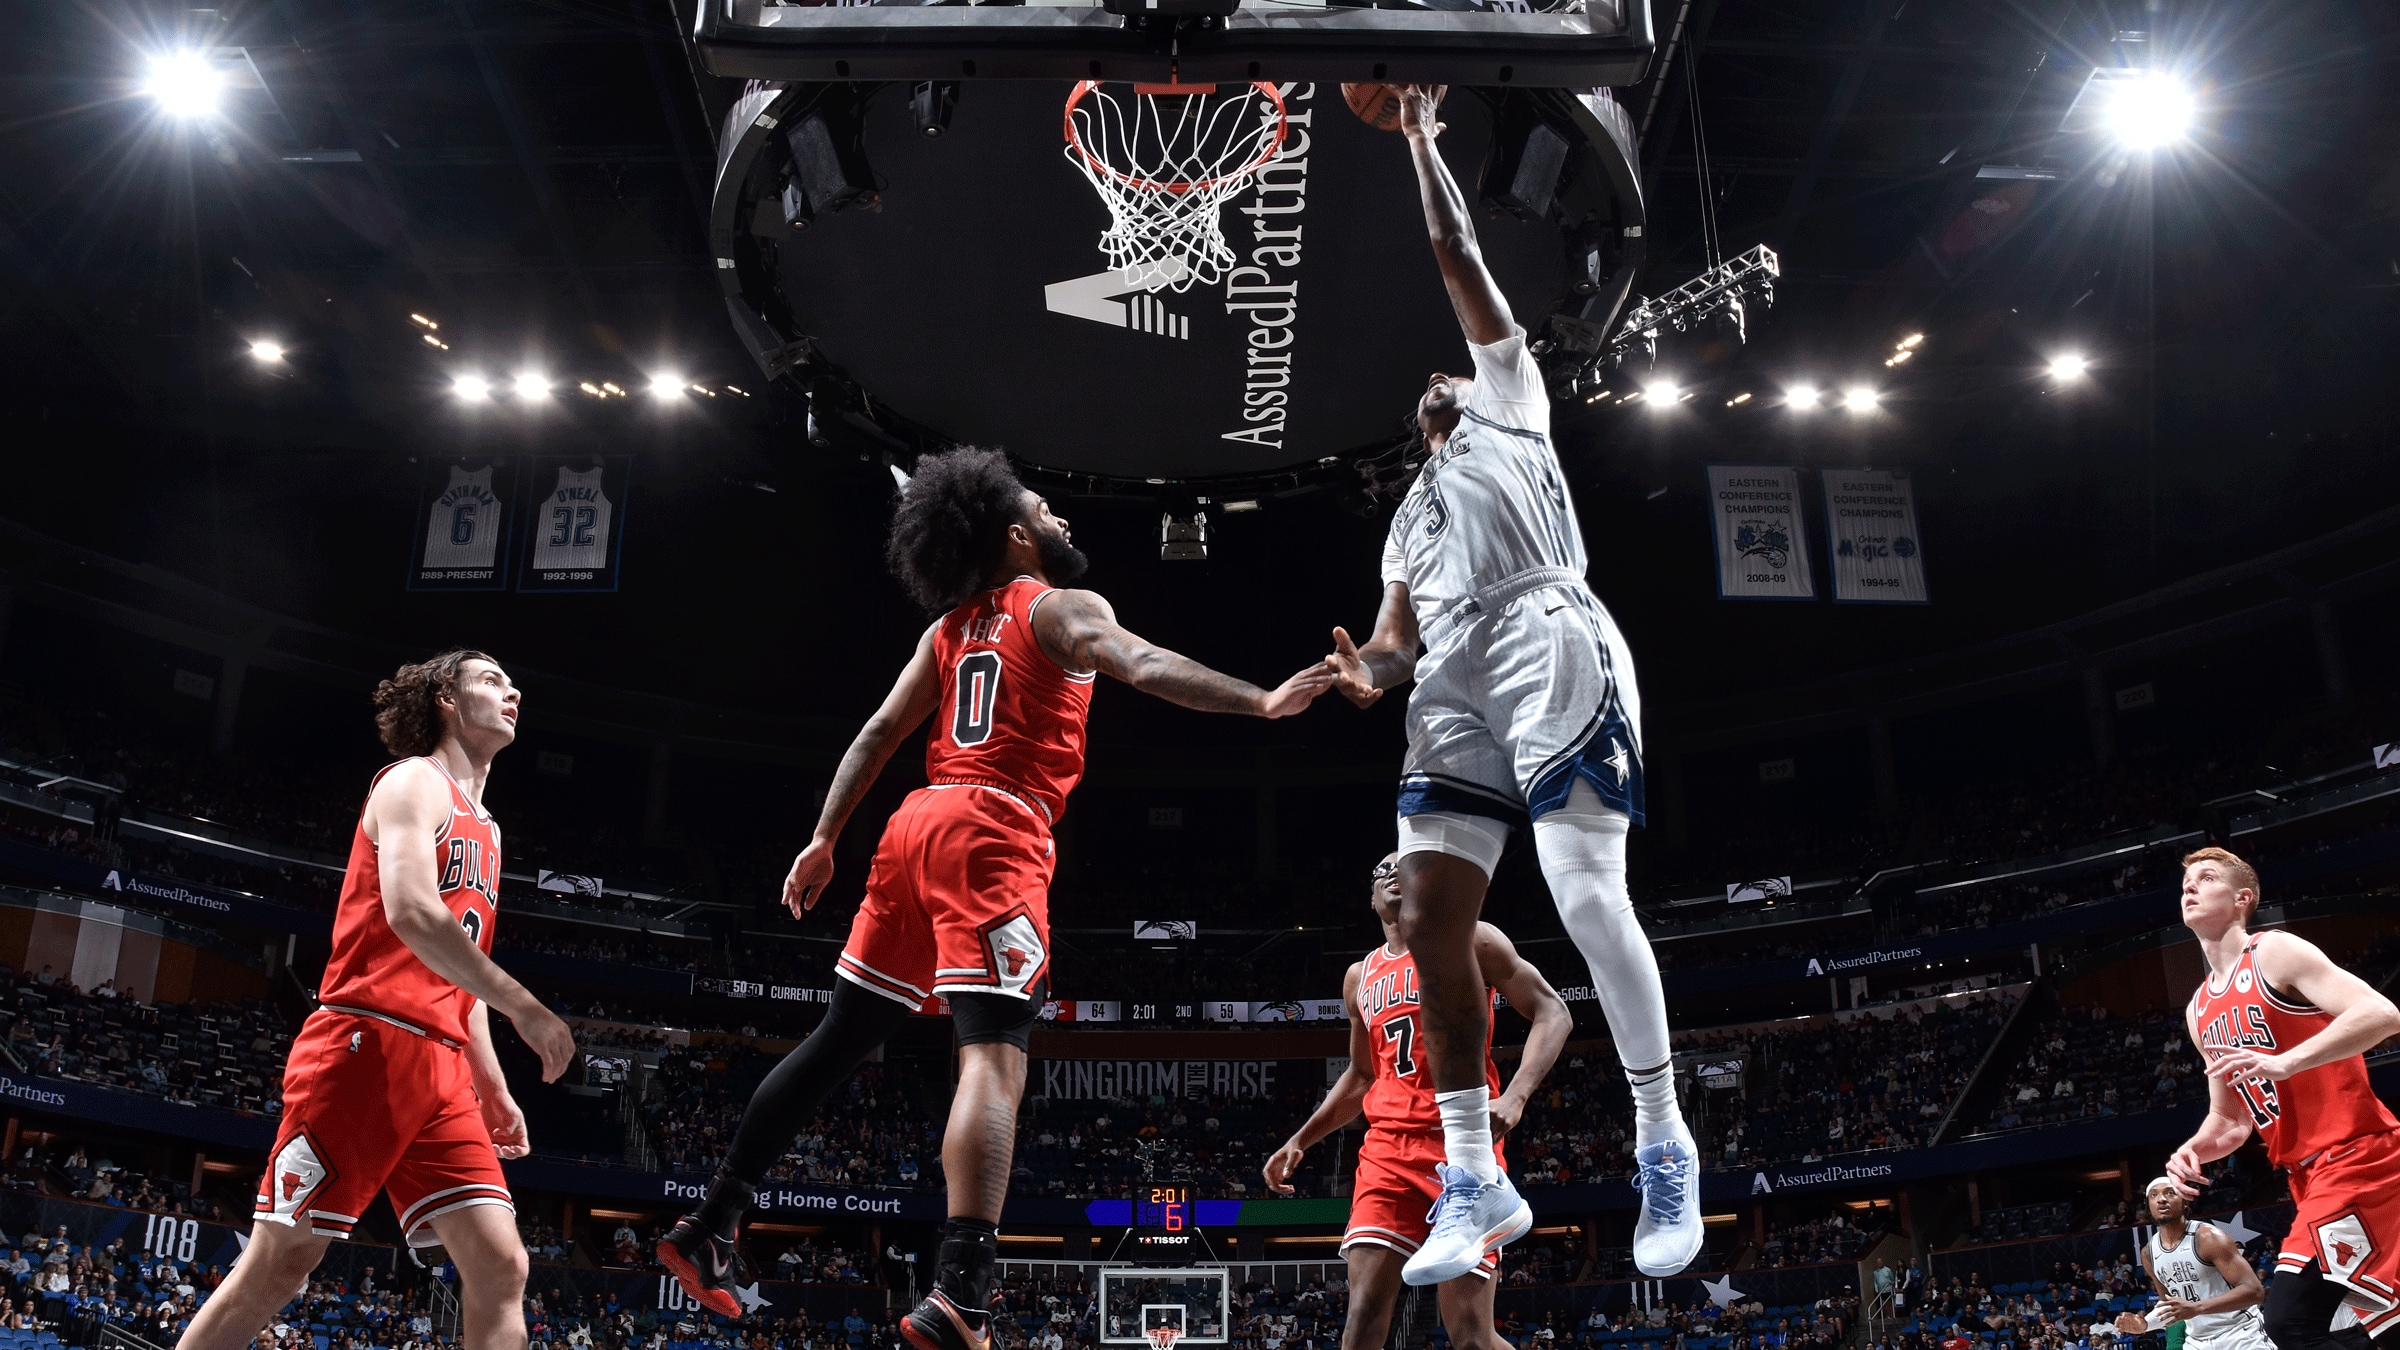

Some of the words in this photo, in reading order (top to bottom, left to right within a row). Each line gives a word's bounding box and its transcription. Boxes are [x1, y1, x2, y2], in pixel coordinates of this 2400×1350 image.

[1220, 82, 1317, 450] AssuredPartners
[1729, 478, 1779, 488] EASTERN
[1843, 483, 1893, 492] EASTERN
[557, 487, 599, 503] O'NEAL
[1719, 491, 1793, 501] CONFERENCE
[1833, 495, 1906, 505] CONFERENCE
[1422, 480, 1451, 540] 3
[1725, 504, 1790, 514] CHAMPIONS
[1839, 508, 1903, 519] CHAMPIONS
[451, 503, 477, 545] 6
[550, 505, 598, 547] 32
[420, 570, 495, 580] 1989-PRESENT
[542, 571, 594, 581] 1992-1996
[1746, 574, 1786, 583] 2008-09
[1861, 578, 1900, 588] 1994-95
[951, 650, 1003, 748] 0
[438, 837, 499, 911] BULL
[126, 877, 231, 912] AssuredPartners
[1827, 947, 1922, 971] AssuredPartners
[770, 985, 813, 1002] CURRENT
[1091, 1003, 1105, 1018] 64
[1133, 1004, 1156, 1020] 2:01
[1175, 1005, 1193, 1018] 2ND
[1220, 1003, 1234, 1018] 59
[1318, 1004, 1341, 1015] BONUS
[1382, 1015, 1417, 1078] 7
[1043, 1059, 1180, 1100] KINGDOM
[1213, 1060, 1278, 1100] RISE
[0, 1076, 66, 1106] Partners
[1775, 1163, 1892, 1188] AssuredPartners
[778, 1190, 838, 1209] Home
[844, 1195, 902, 1214] Court
[1151, 1187, 1186, 1204] 2:01
[1165, 1203, 1183, 1231] 6
[144, 1213, 199, 1263] 108
[1152, 1236, 1190, 1245] TISSOT
